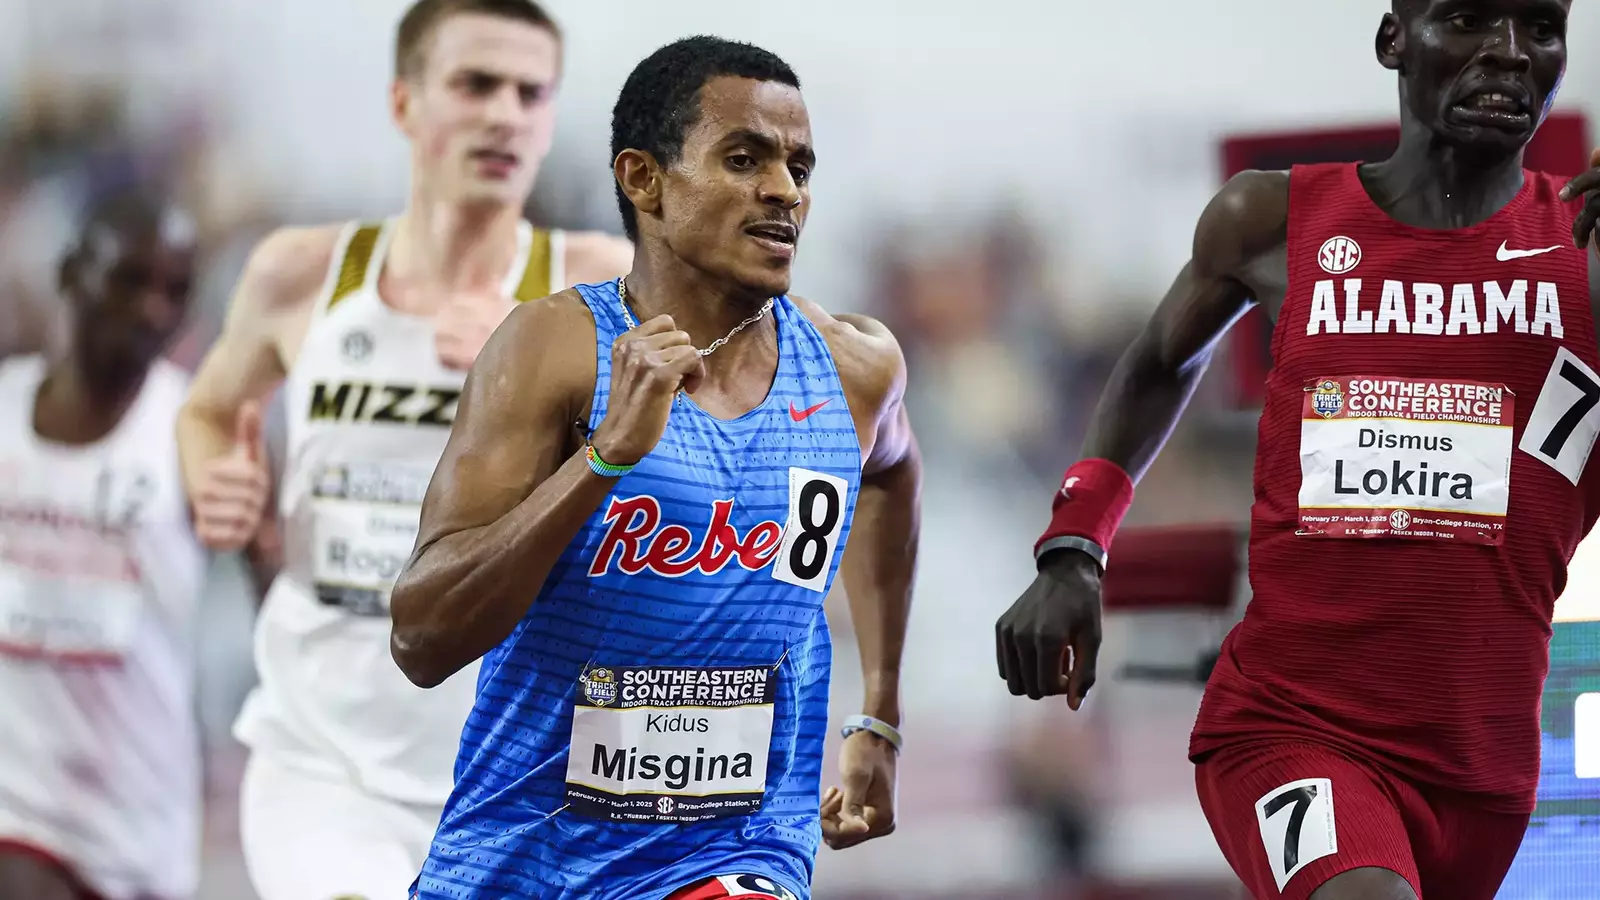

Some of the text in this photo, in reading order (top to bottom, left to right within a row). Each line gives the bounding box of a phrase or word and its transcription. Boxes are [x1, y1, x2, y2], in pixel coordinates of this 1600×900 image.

[1319, 238, 1360, 273] SEC
[1306, 279, 1564, 338] ALABAMA
[1314, 394, 1342, 402] TRACK
[1348, 380, 1502, 402] SOUTHEASTERN
[310, 382, 461, 426] MIZZ
[1348, 395, 1501, 417] CONFERENCE
[1539, 359, 1600, 460] 7
[1378, 410, 1403, 418] TRACK
[1437, 413, 1500, 425] CHAMPIONSHIPS
[1358, 428, 1453, 451] Dismus
[1334, 459, 1473, 500] Lokira
[1302, 515, 1330, 523] February
[1390, 510, 1410, 529] SEC
[1412, 517, 1463, 528] Bryan-College
[1463, 520, 1491, 530] Station,
[587, 495, 788, 577] Rebe
[789, 479, 839, 580] 8
[585, 681, 615, 690] TRACK
[622, 668, 768, 685] SOUTHEASTERN
[593, 688, 616, 697] FIELD
[622, 683, 766, 701] CONFERENCE
[621, 699, 647, 708] INDOOR
[649, 699, 674, 707] TRACK
[706, 697, 763, 707] CHAMPIONSHIPS
[646, 713, 709, 733] Kidus
[591, 743, 753, 790] Misgina
[567, 790, 597, 802] February
[657, 796, 674, 814] SEC
[678, 802, 724, 811] Bryan-College
[1263, 785, 1317, 875] 7
